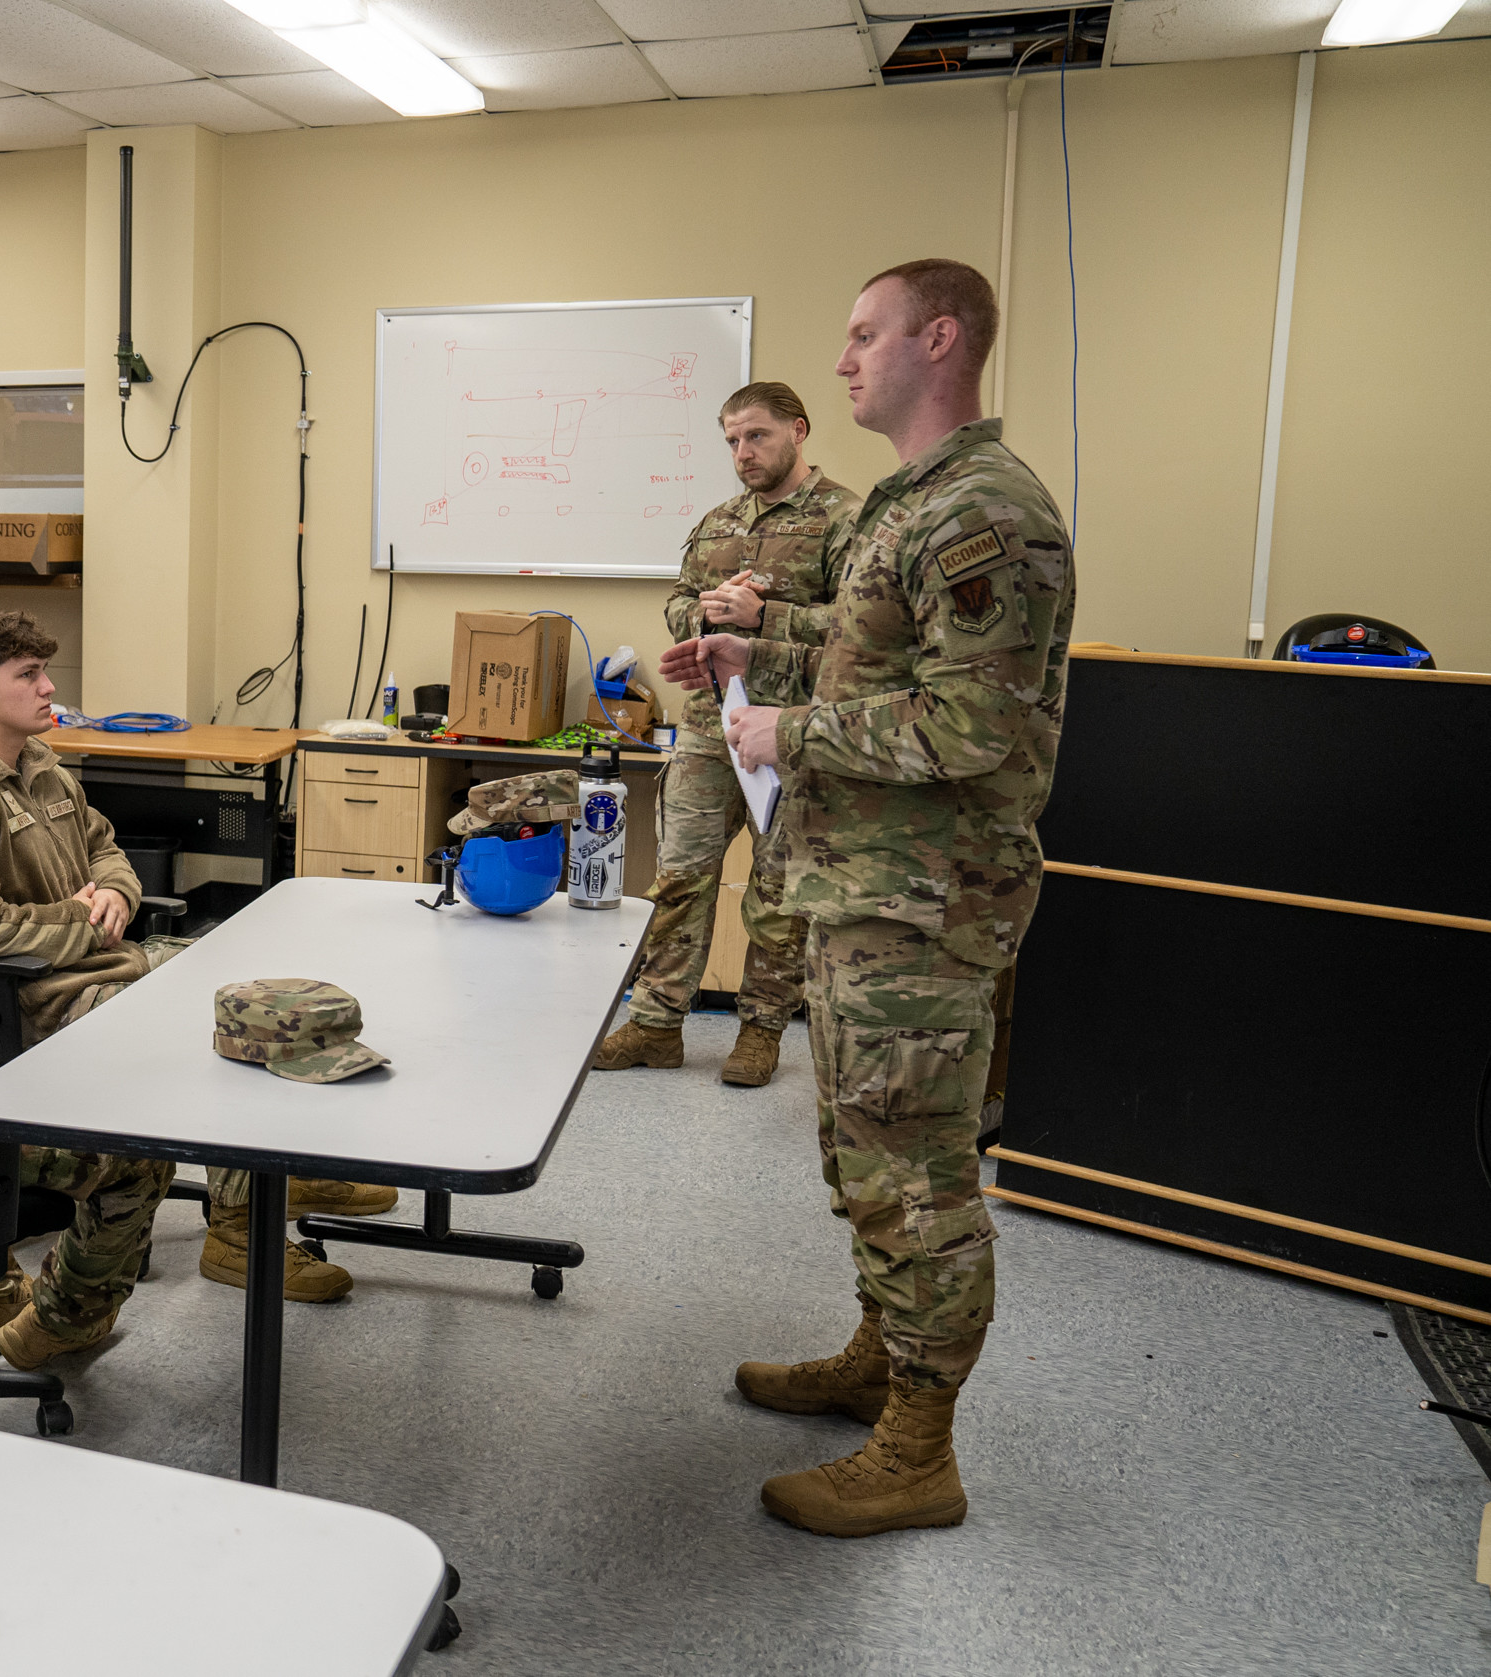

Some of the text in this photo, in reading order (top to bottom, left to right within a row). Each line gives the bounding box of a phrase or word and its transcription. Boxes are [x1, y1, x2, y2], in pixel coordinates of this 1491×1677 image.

[941, 534, 998, 572] XCOMM
[512, 666, 521, 687] buying
[521, 666, 529, 687] Thank
